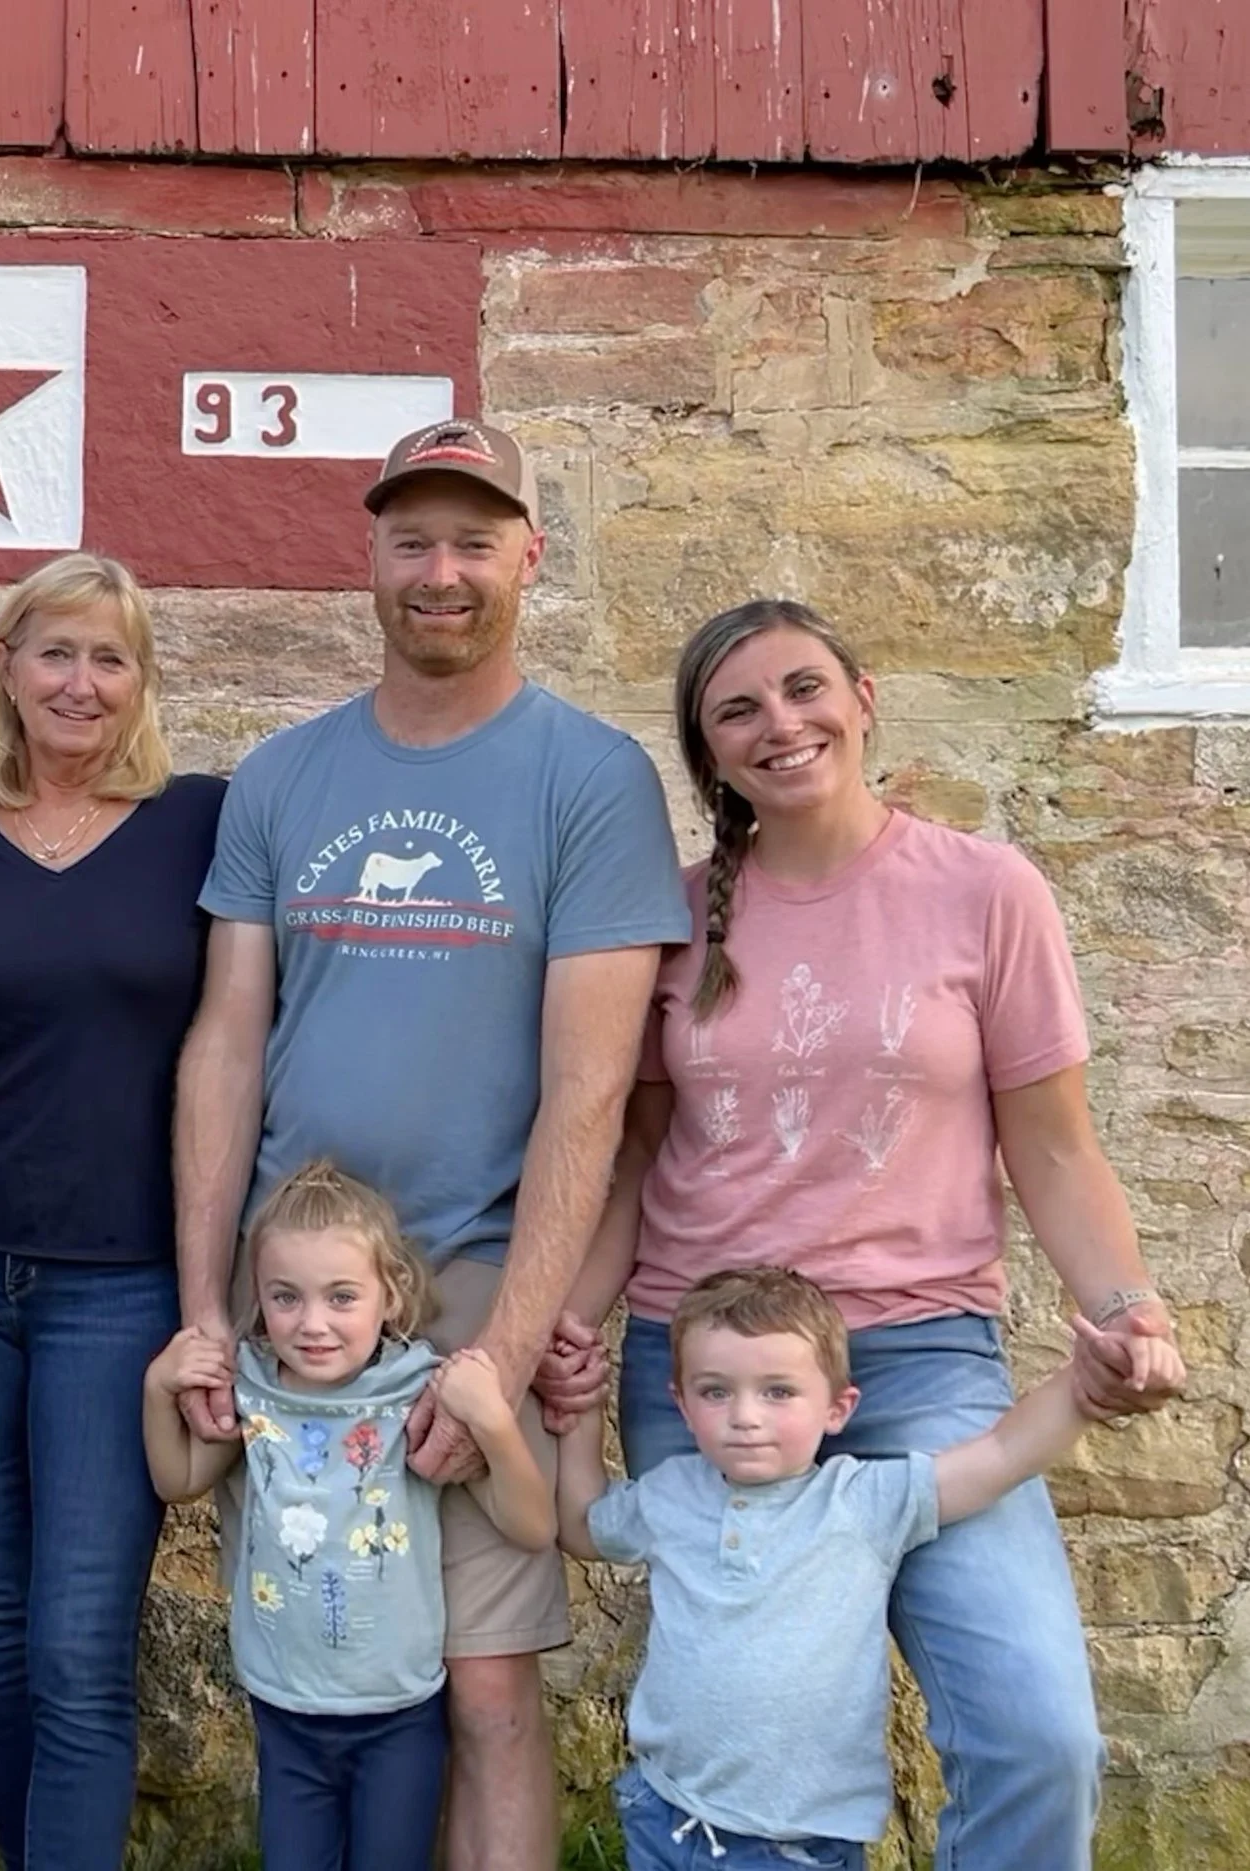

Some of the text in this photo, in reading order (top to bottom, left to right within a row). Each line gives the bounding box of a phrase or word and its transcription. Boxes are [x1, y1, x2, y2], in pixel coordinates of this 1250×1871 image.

[194, 383, 298, 447] 93
[296, 809, 505, 904] CATES FAMILY FARM
[380, 911, 464, 930] FINISHED
[466, 916, 516, 939] BEEF
